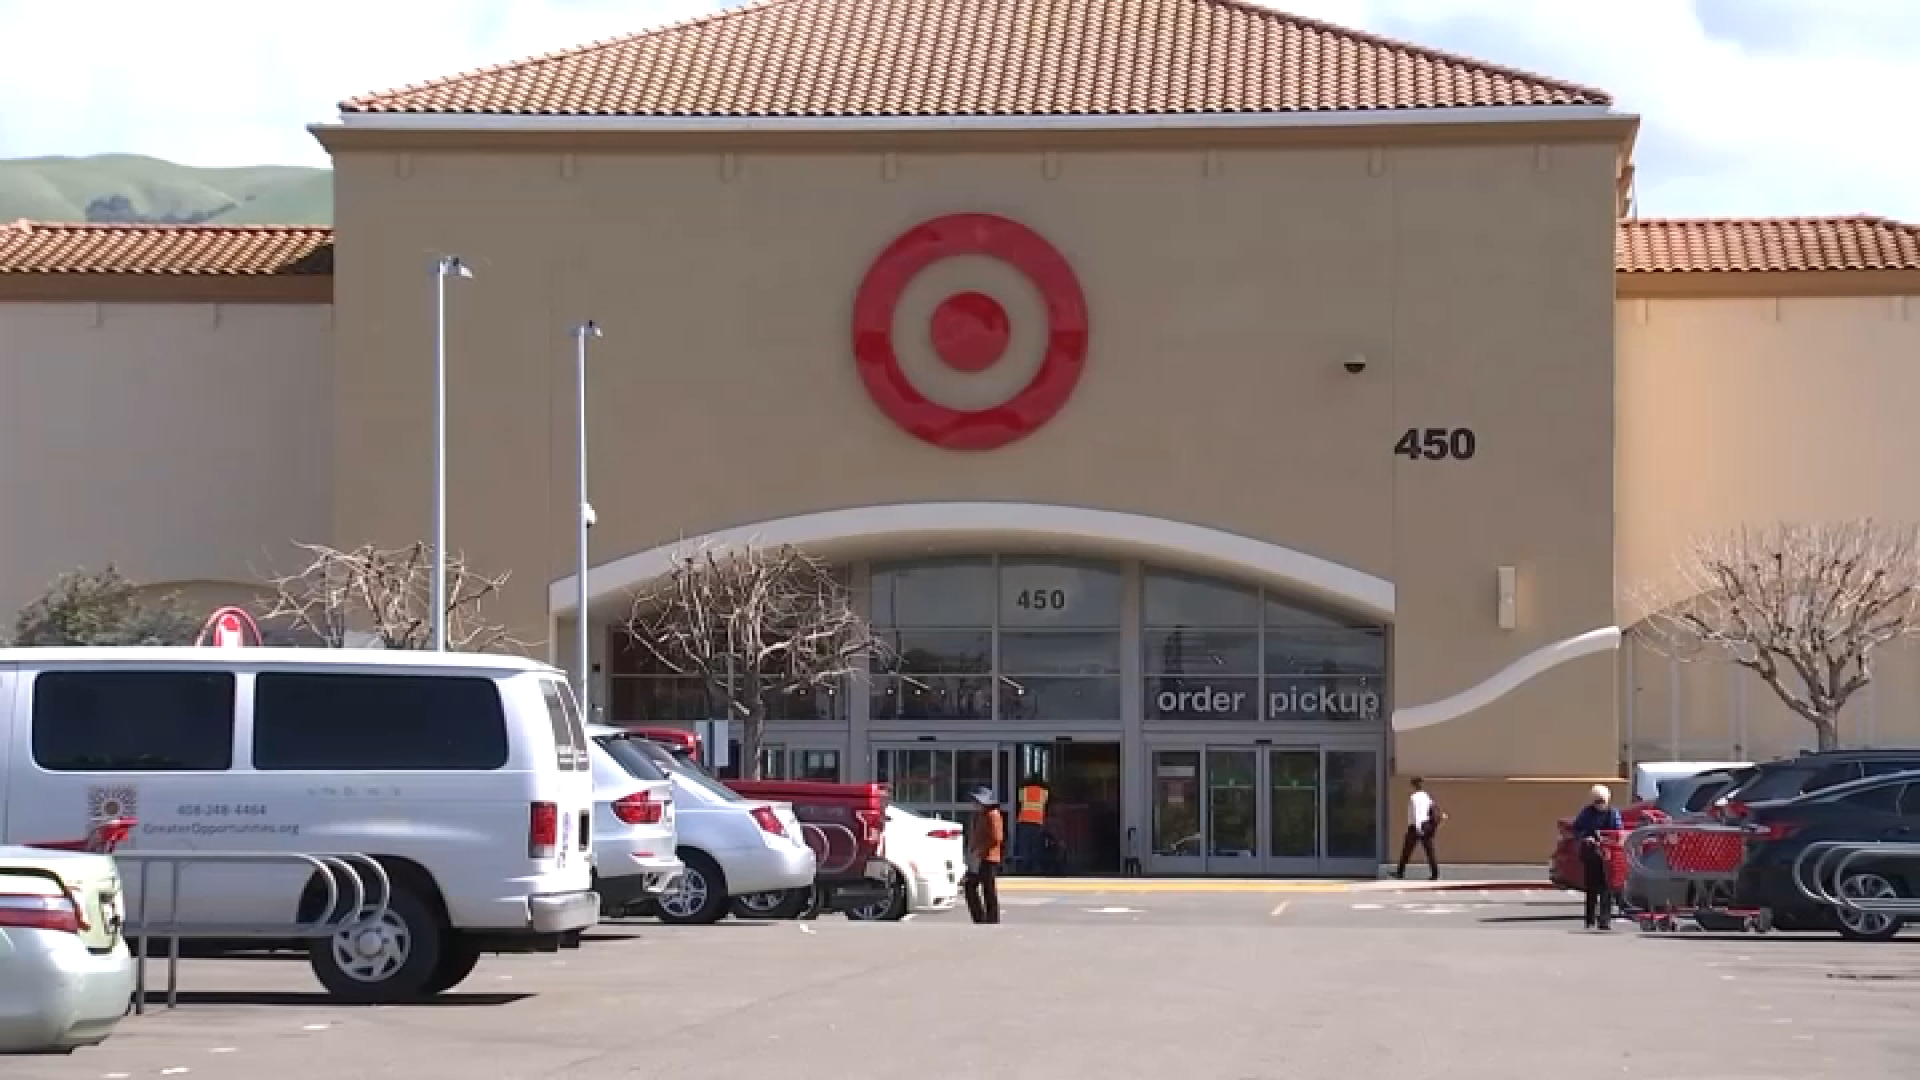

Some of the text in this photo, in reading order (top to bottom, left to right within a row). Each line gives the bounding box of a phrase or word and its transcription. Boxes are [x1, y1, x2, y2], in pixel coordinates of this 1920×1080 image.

[1394, 427, 1475, 460] 450
[1016, 588, 1065, 610] 450
[1157, 685, 1380, 719] order pickup
[143, 822, 300, 837] GreaterOpportunities.org
